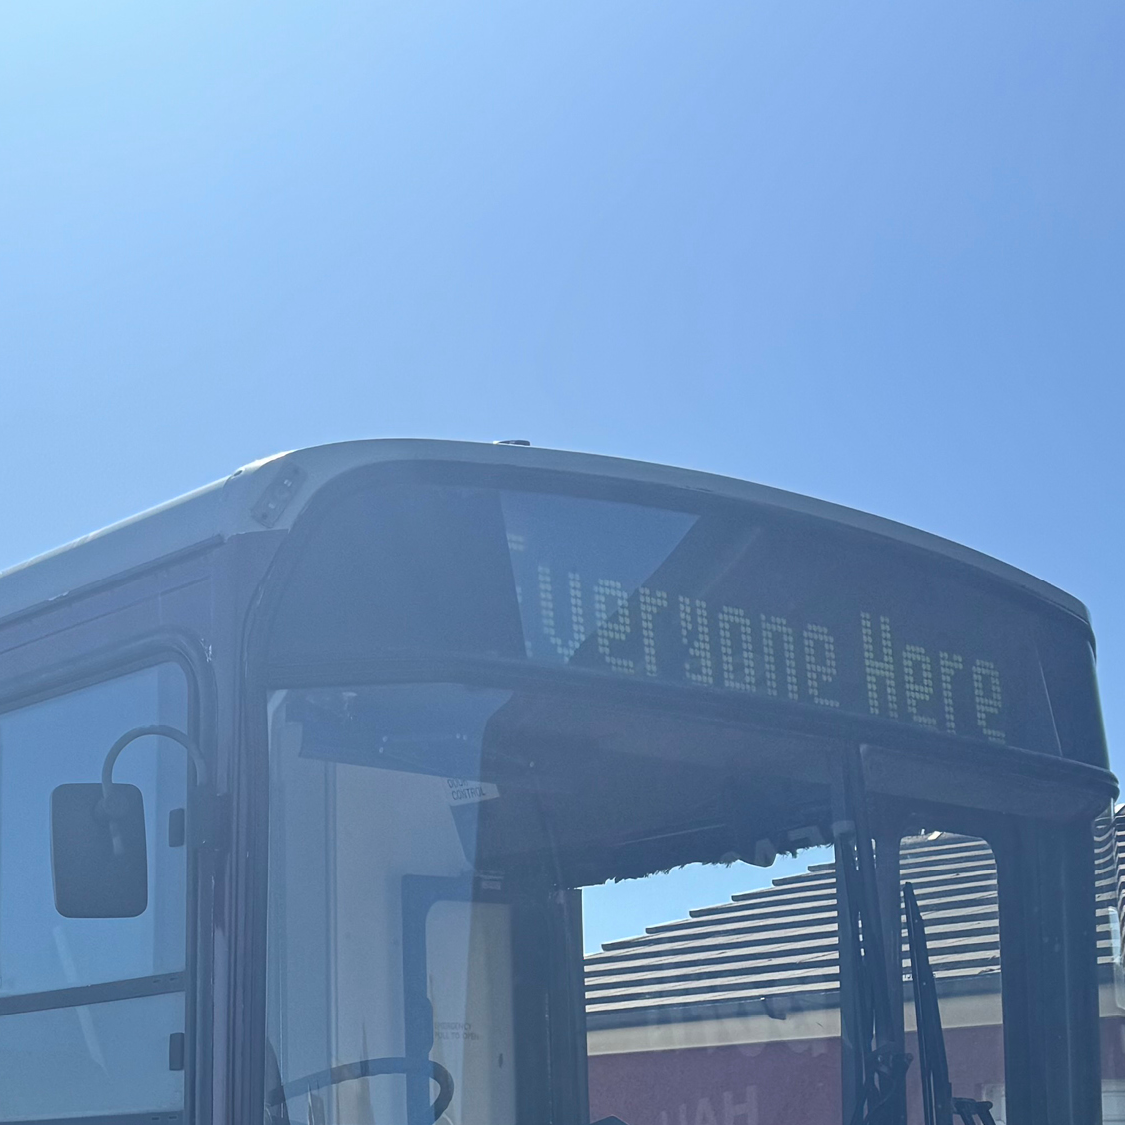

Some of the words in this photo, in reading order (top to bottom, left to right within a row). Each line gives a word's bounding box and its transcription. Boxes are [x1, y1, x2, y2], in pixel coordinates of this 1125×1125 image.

[507, 534, 840, 707] veryone
[860, 610, 1006, 743] Here
[452, 786, 485, 800] CONTROL
